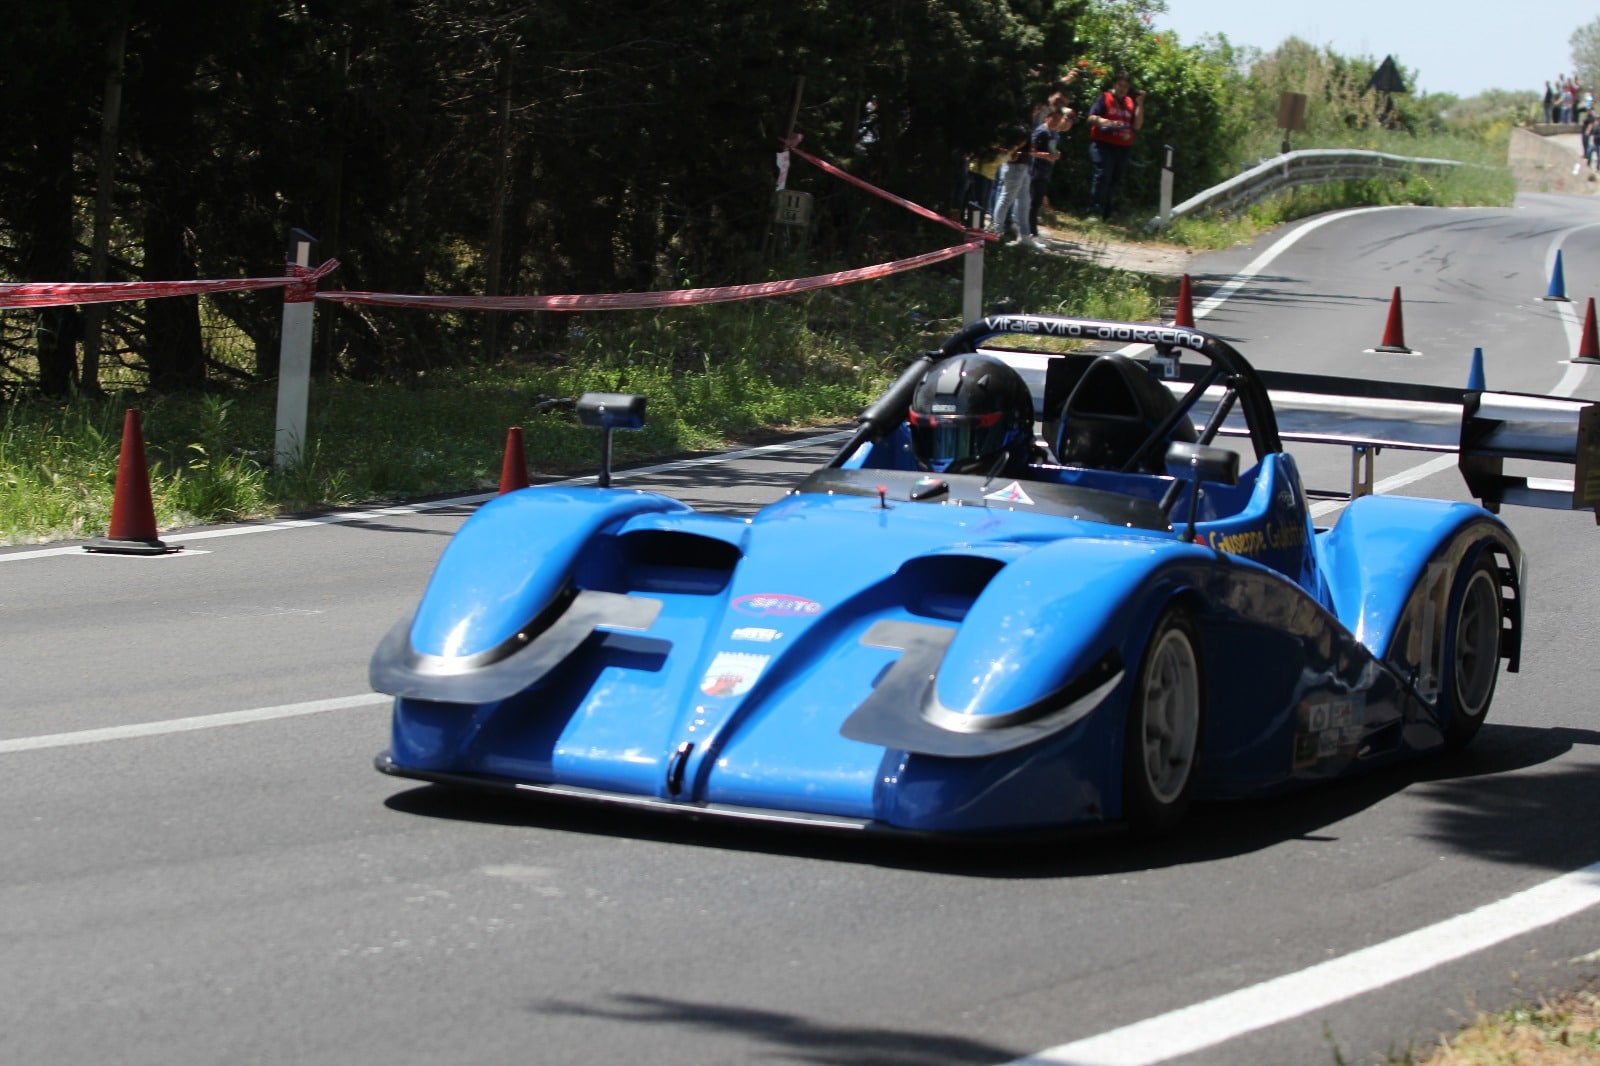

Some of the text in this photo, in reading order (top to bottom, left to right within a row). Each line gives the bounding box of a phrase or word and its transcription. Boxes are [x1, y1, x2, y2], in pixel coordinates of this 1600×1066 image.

[984, 316, 1040, 333] Vitale
[1042, 321, 1082, 336] Vito
[1132, 328, 1205, 350] Racing
